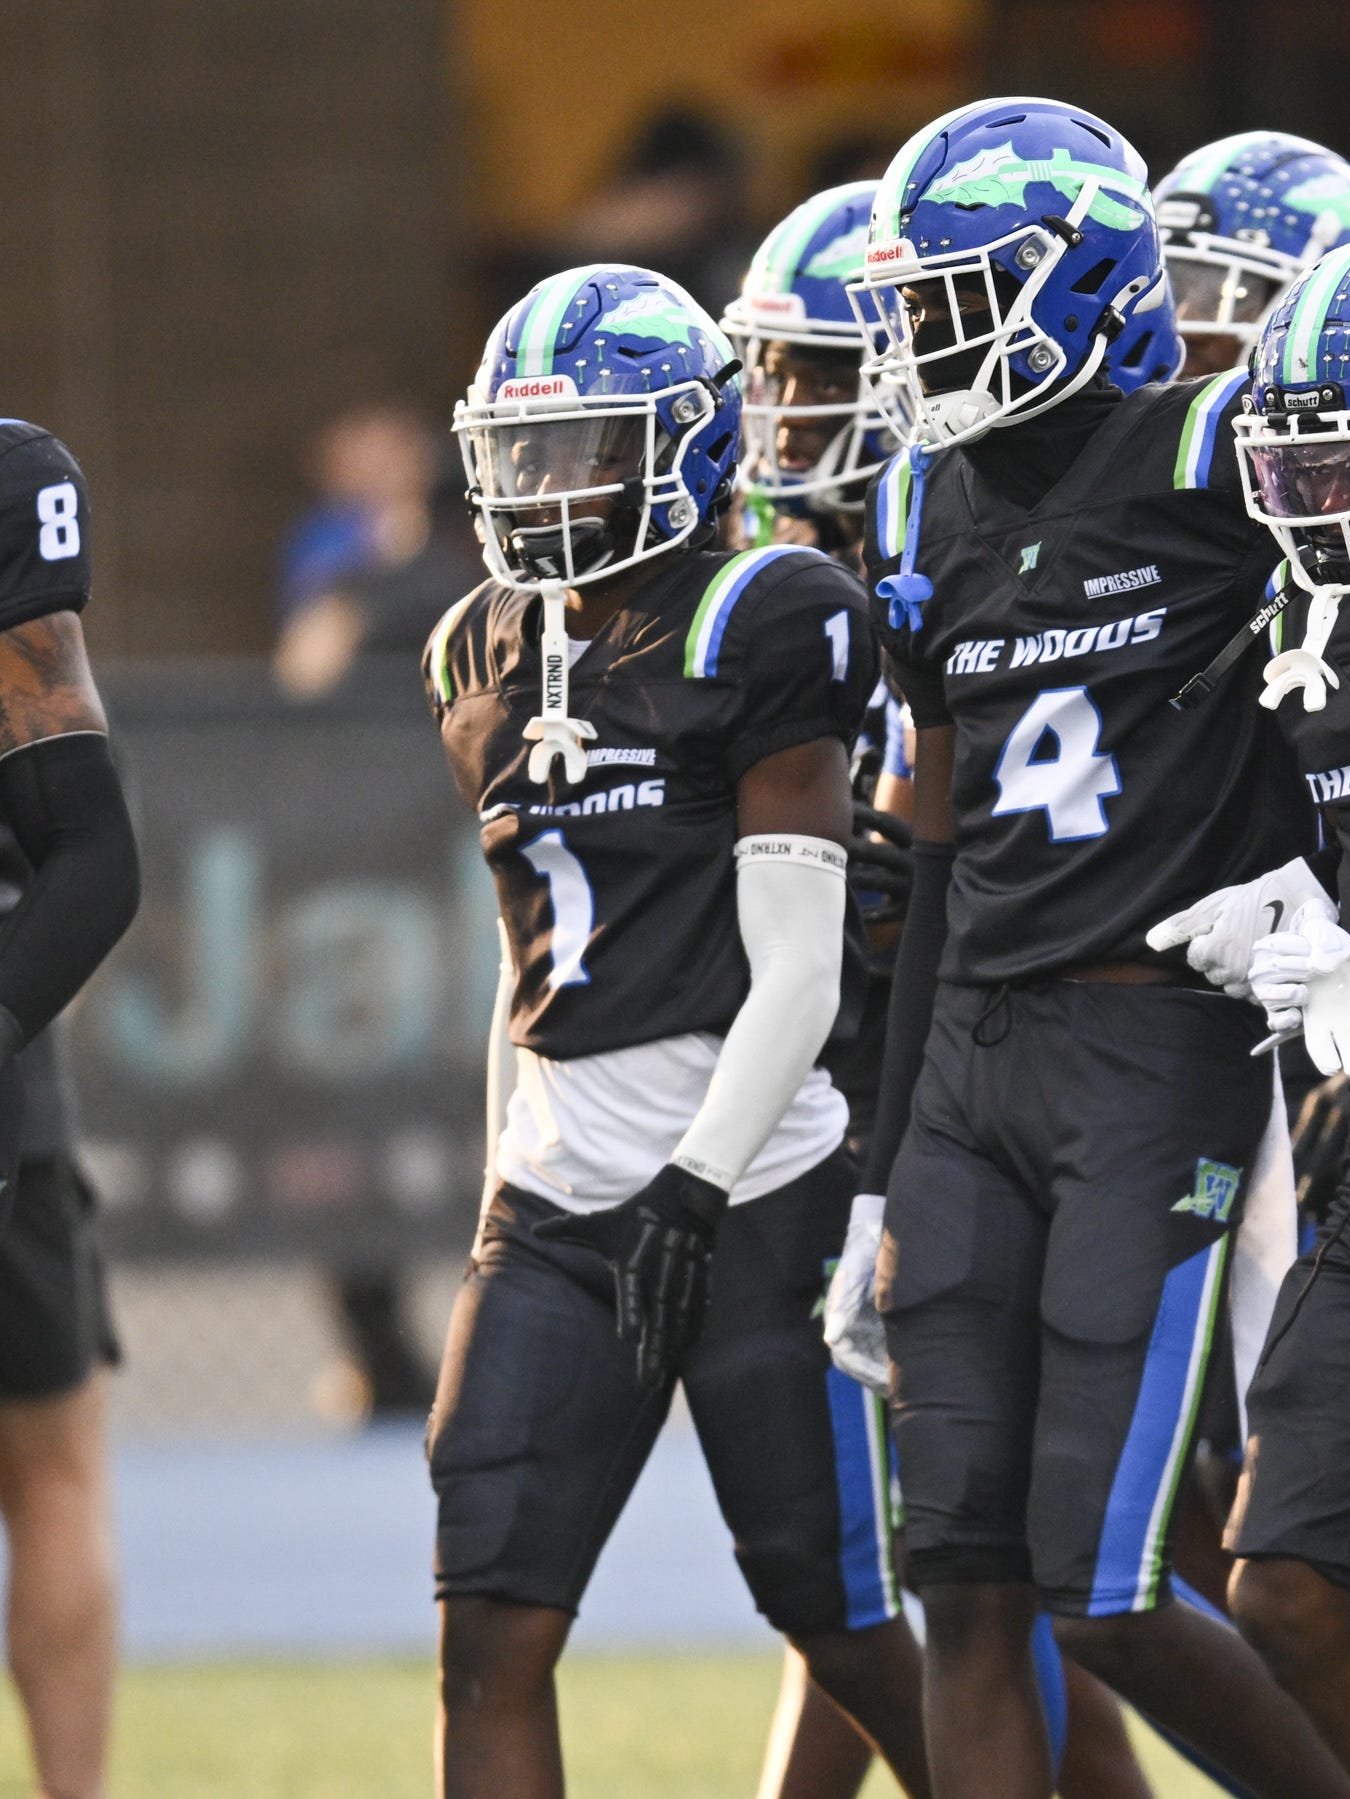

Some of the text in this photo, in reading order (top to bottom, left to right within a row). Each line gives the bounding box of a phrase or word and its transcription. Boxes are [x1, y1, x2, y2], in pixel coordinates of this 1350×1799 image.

[504, 381, 564, 399] Riddell
[1287, 396, 1318, 408] schutt
[37, 483, 81, 561] 8
[1084, 565, 1162, 599] IMPRESSIVE
[946, 606, 1168, 675] THE WOODS
[1249, 591, 1290, 635] schutt
[824, 610, 851, 684] 1
[546, 654, 563, 709] NXTRND
[991, 684, 1123, 844] 4
[750, 842, 792, 856] NXTRND
[520, 828, 594, 988] 1
